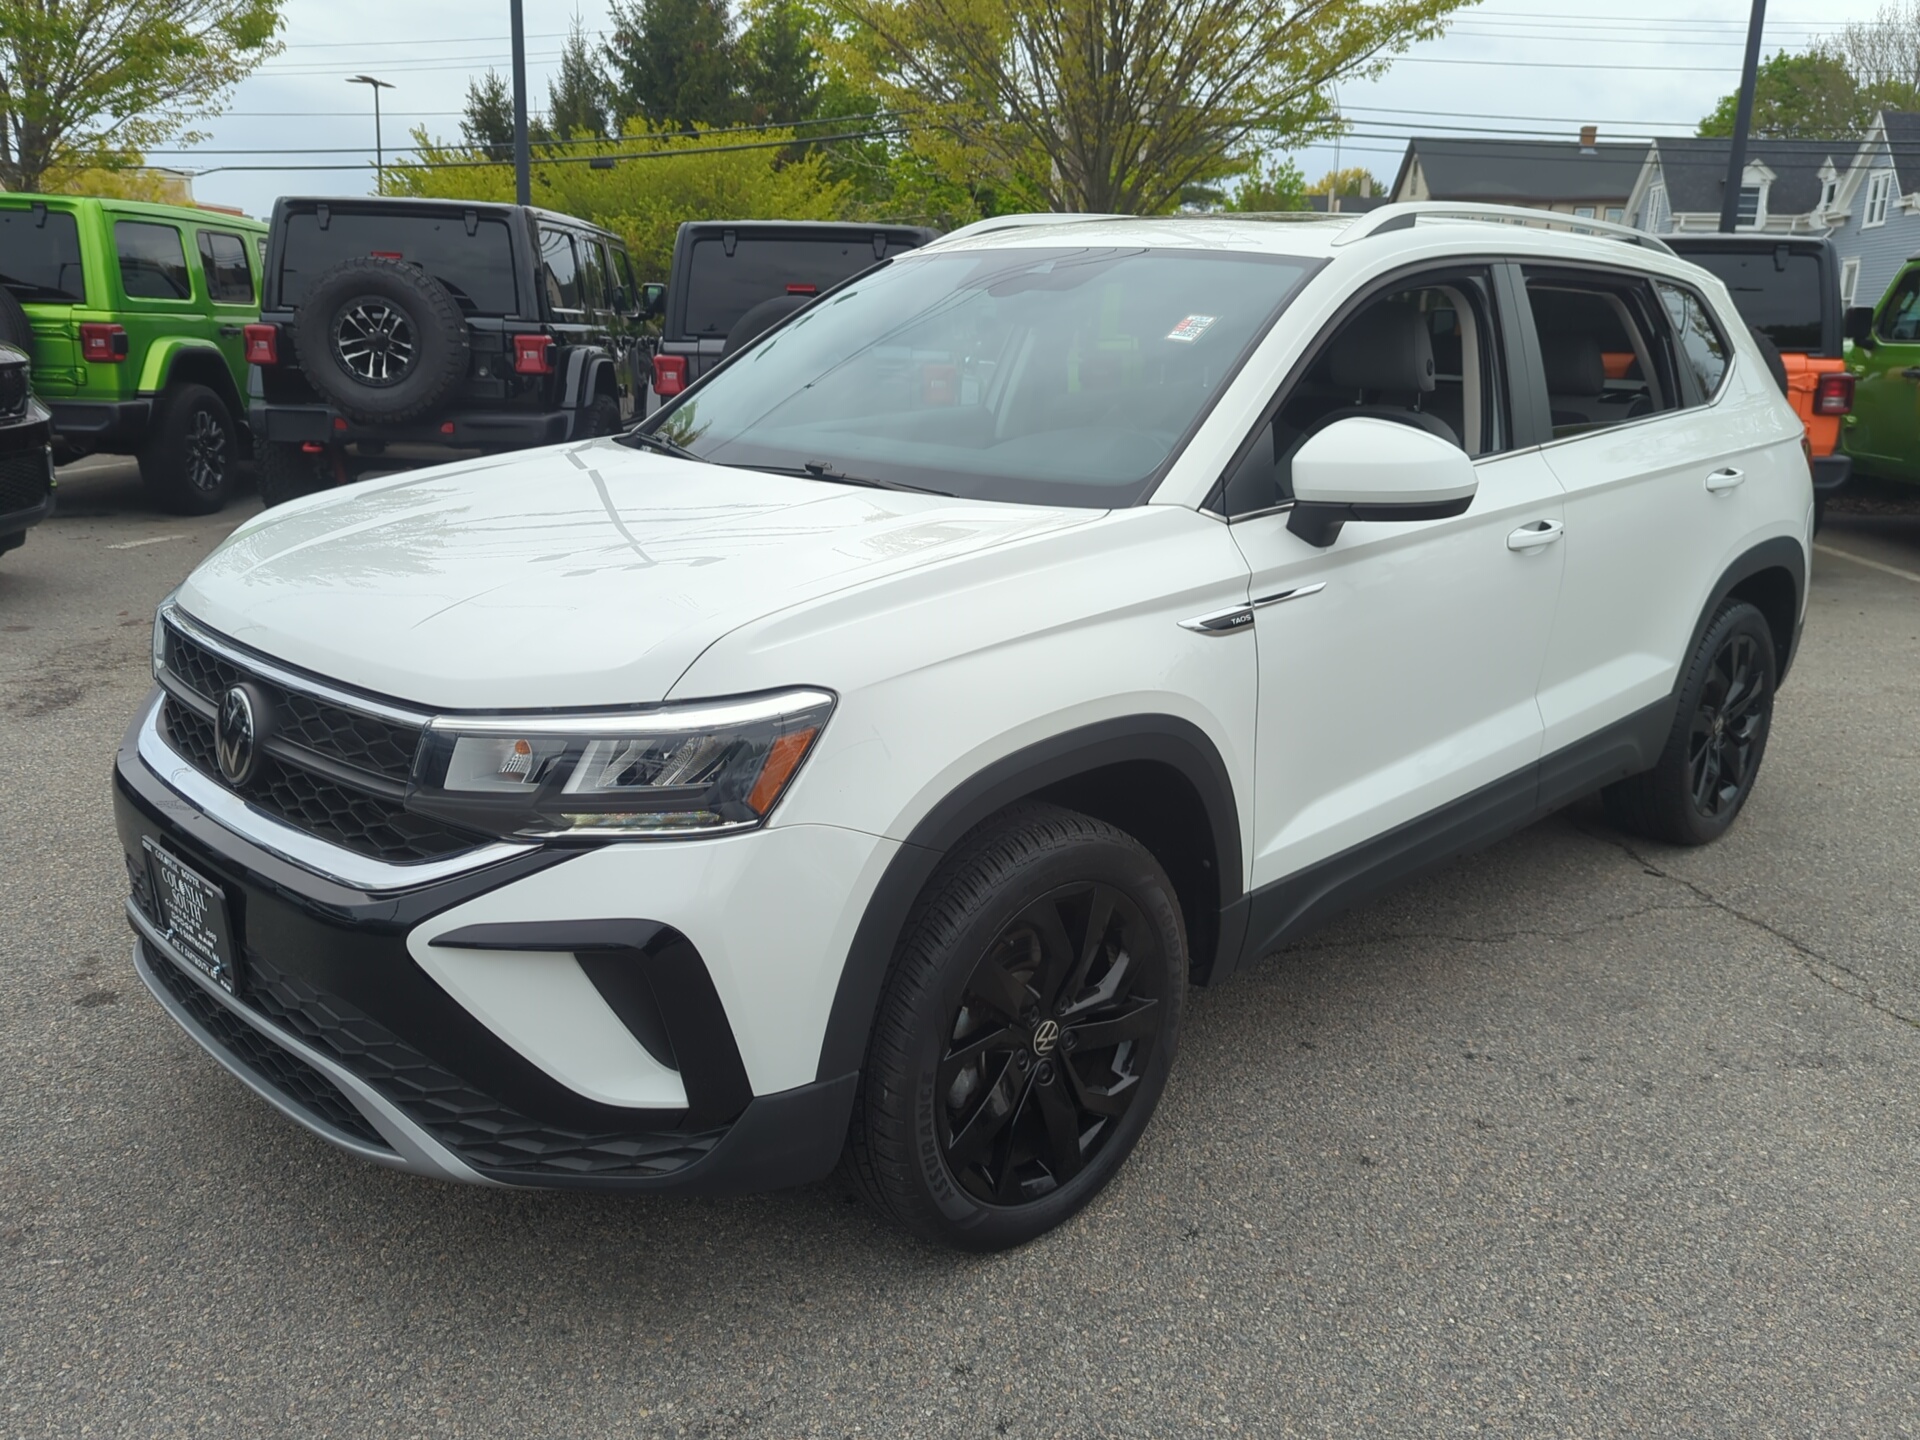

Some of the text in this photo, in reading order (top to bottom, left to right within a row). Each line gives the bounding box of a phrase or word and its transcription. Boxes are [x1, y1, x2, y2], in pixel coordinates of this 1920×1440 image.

[1231, 615, 1251, 625] TAOS
[161, 867, 207, 912] COLONIAL
[172, 889, 203, 923] SOUTH
[918, 1070, 956, 1203] ASSURANCE
